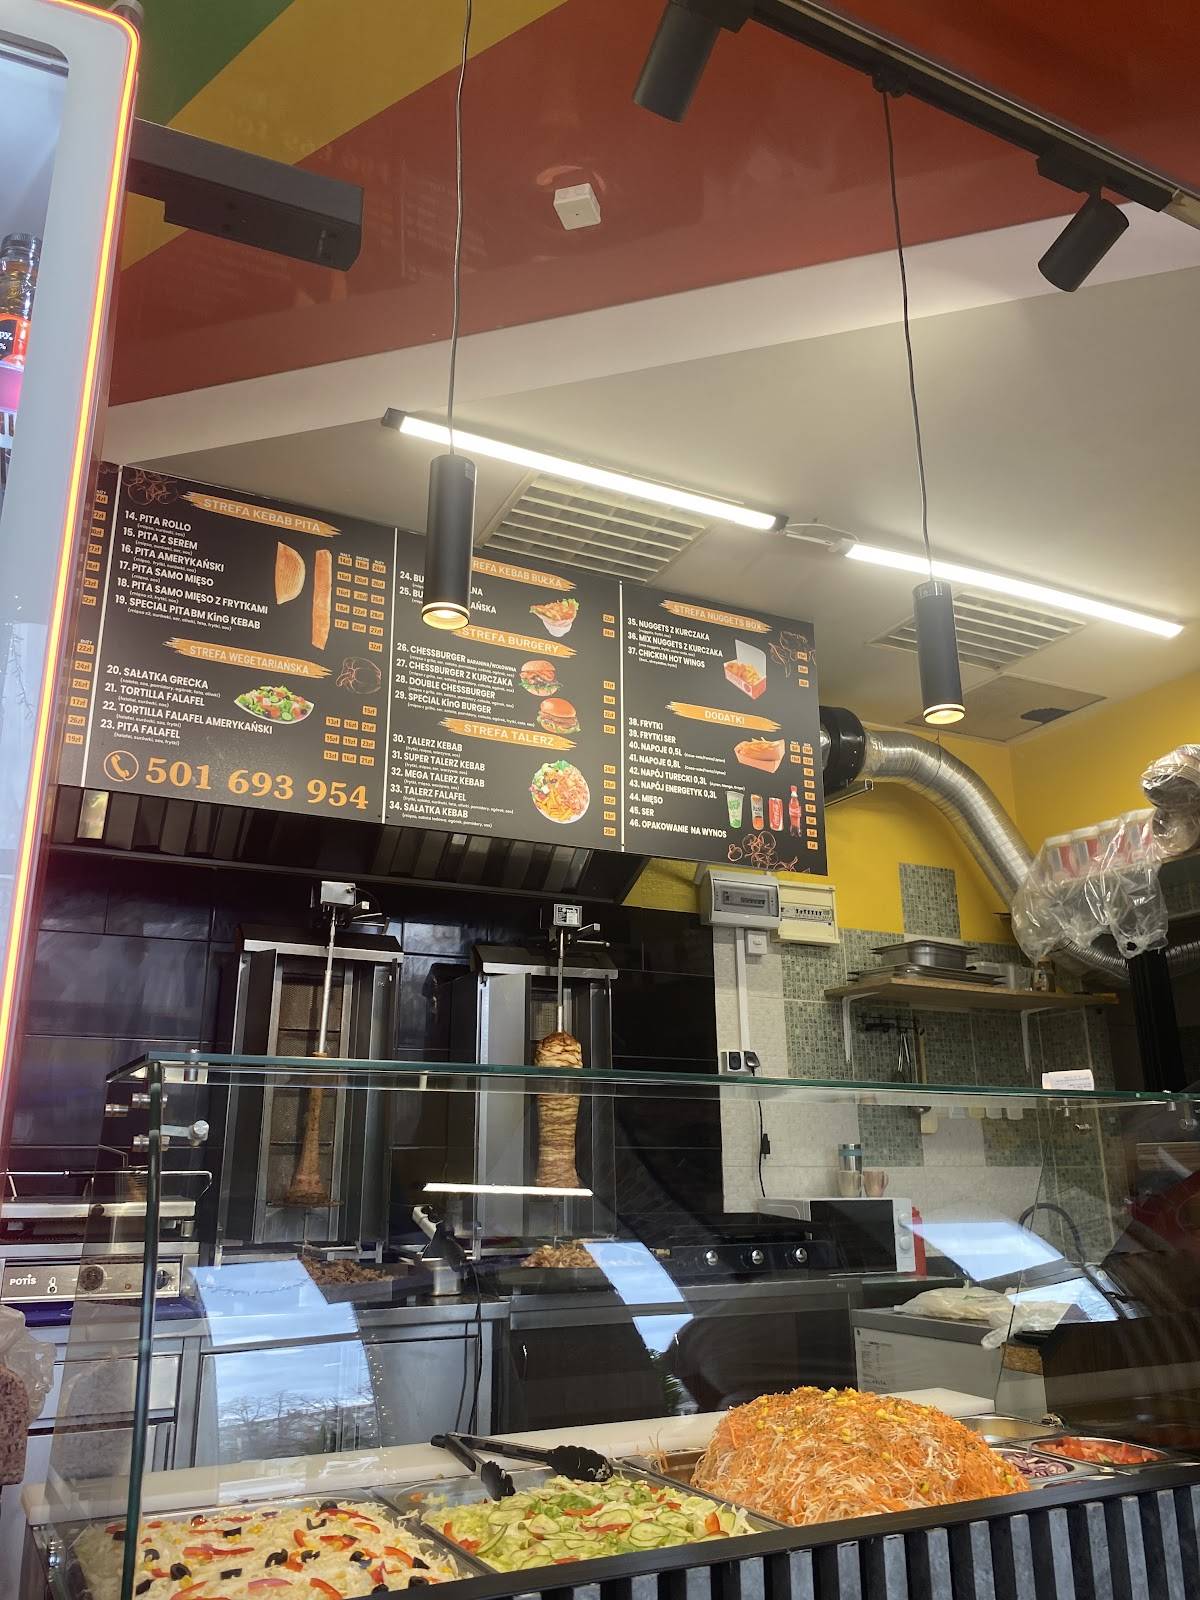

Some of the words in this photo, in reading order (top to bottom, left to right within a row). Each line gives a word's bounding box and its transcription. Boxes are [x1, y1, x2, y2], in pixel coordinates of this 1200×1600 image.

[125, 510, 138, 521] 14.
[139, 513, 160, 526] PITA
[162, 519, 192, 532] ROLLO
[202, 499, 249, 516] STREFA
[253, 508, 292, 528] KEBAB
[295, 517, 321, 533] PITA
[123, 526, 136, 538] 15.
[137, 530, 158, 543] PITA
[160, 534, 166, 544] Z
[168, 536, 198, 550] SEREM
[121, 543, 134, 554] 16.
[135, 546, 156, 559] PITA
[157, 549, 224, 572] AMERYKAŃSKI
[119, 560, 131, 571] 17.
[132, 563, 153, 575] PITA
[155, 568, 183, 581] SAMO
[184, 573, 214, 587] MIĘSO
[400, 570, 412, 581] 24.
[499, 565, 530, 580] KEBAB
[117, 577, 130, 588] 18.
[131, 581, 153, 593] PITA
[154, 585, 184, 598] SAMO
[184, 590, 214, 604] MIĘSO
[215, 596, 221, 605] Z
[222, 598, 269, 614] FRYTKAMI
[399, 586, 412, 596] 25.
[115, 594, 128, 606] 19.
[129, 597, 168, 613] SPECIAL
[231, 616, 261, 630] KEBAB
[674, 604, 706, 618] STREFA
[627, 617, 638, 627] 35.
[638, 620, 669, 632] NUGGETS
[670, 626, 674, 634] Z
[675, 627, 710, 640] KURCZAKA
[462, 628, 506, 644] STREFA
[510, 637, 560, 654] BURGERY
[627, 631, 638, 640] 36.
[639, 634, 652, 644] MIX
[652, 636, 683, 649] NUGGETS
[688, 644, 723, 657] KURCZAKA
[190, 645, 227, 660] STREFA
[229, 652, 309, 675] WEGETARIAŃSKA
[397, 642, 409, 653] 26.
[410, 645, 466, 663] CHESSBURGER
[627, 646, 638, 655] 37.
[638, 648, 668, 660] CHICKEN
[669, 654, 682, 664] HOT
[683, 657, 705, 668] WINGS
[106, 664, 122, 675] 20.
[123, 668, 168, 683] SAŁATKA
[169, 675, 209, 689] GRECKA
[396, 658, 408, 668] 27.
[409, 661, 465, 678] CHESSBURGER
[472, 672, 513, 687] KURCZAKA
[104, 682, 117, 693] 21.
[120, 685, 165, 701] TORTILLA
[166, 692, 205, 707] FALAFEL
[395, 674, 408, 684] 28.
[409, 677, 440, 689] DOUBLE
[441, 683, 496, 699] CHESSBURGER
[395, 690, 407, 699] 29.
[408, 693, 440, 706] SPECIAL
[461, 701, 492, 714] BURGER
[102, 701, 117, 711] 22.
[119, 703, 163, 719] TORTILLA
[165, 711, 204, 725] FALAFEL
[206, 716, 273, 734] AMERYKAŃSKI
[628, 717, 639, 726] 38.
[640, 720, 663, 730] FRYTKI
[704, 710, 745, 724] DODATKI
[100, 719, 115, 730] 23.
[117, 721, 139, 733] PITA
[141, 725, 181, 739] FALAFEL
[464, 723, 508, 739] STREFA
[512, 731, 554, 746] TALERZ
[628, 729, 639, 738] 39.
[640, 731, 663, 742] FRYTKI
[664, 735, 677, 744] SER
[393, 734, 405, 744] 30.
[406, 736, 436, 748] TALERZ
[436, 740, 463, 752] KEBAB
[629, 741, 640, 749] 40.
[641, 742, 667, 754] NAPOJE
[668, 747, 682, 756] 0,5L
[392, 750, 402, 760] 31.
[404, 752, 429, 764] SUPER
[430, 756, 458, 768] TALERZ
[460, 760, 485, 771] KEBAB
[629, 754, 638, 762] 41.
[639, 755, 666, 766] NAPOJE
[145, 757, 211, 791] 501
[228, 768, 294, 800] 693
[306, 779, 368, 809] 954
[391, 767, 403, 777] 32.
[404, 769, 428, 780] MEGA
[430, 772, 458, 784] TALERZ
[459, 776, 485, 788] KEBAB
[629, 766, 640, 775] 42.
[640, 768, 664, 779] NAPÓJ
[665, 771, 692, 783] TURECKI
[693, 776, 707, 785] 0,3L
[390, 783, 402, 794] 33.
[404, 786, 433, 798] TALERZ
[434, 789, 467, 802] FALAFEL
[629, 792, 641, 801] 44.
[641, 794, 663, 805] MIĘSO
[630, 779, 640, 788] 43.
[641, 781, 664, 791] NAPÓJ
[665, 784, 703, 797] ENERGETYK
[703, 790, 717, 799] 0,3L
[389, 800, 402, 811] 34.
[403, 802, 441, 815] SAŁATKA
[442, 807, 469, 818] KEBAB
[629, 806, 641, 815] 45.
[641, 807, 655, 816] SER
[629, 819, 641, 828] 46.
[641, 820, 689, 834] OPAKOWANIE
[690, 826, 701, 835] NA
[701, 827, 727, 838] WYNOS
